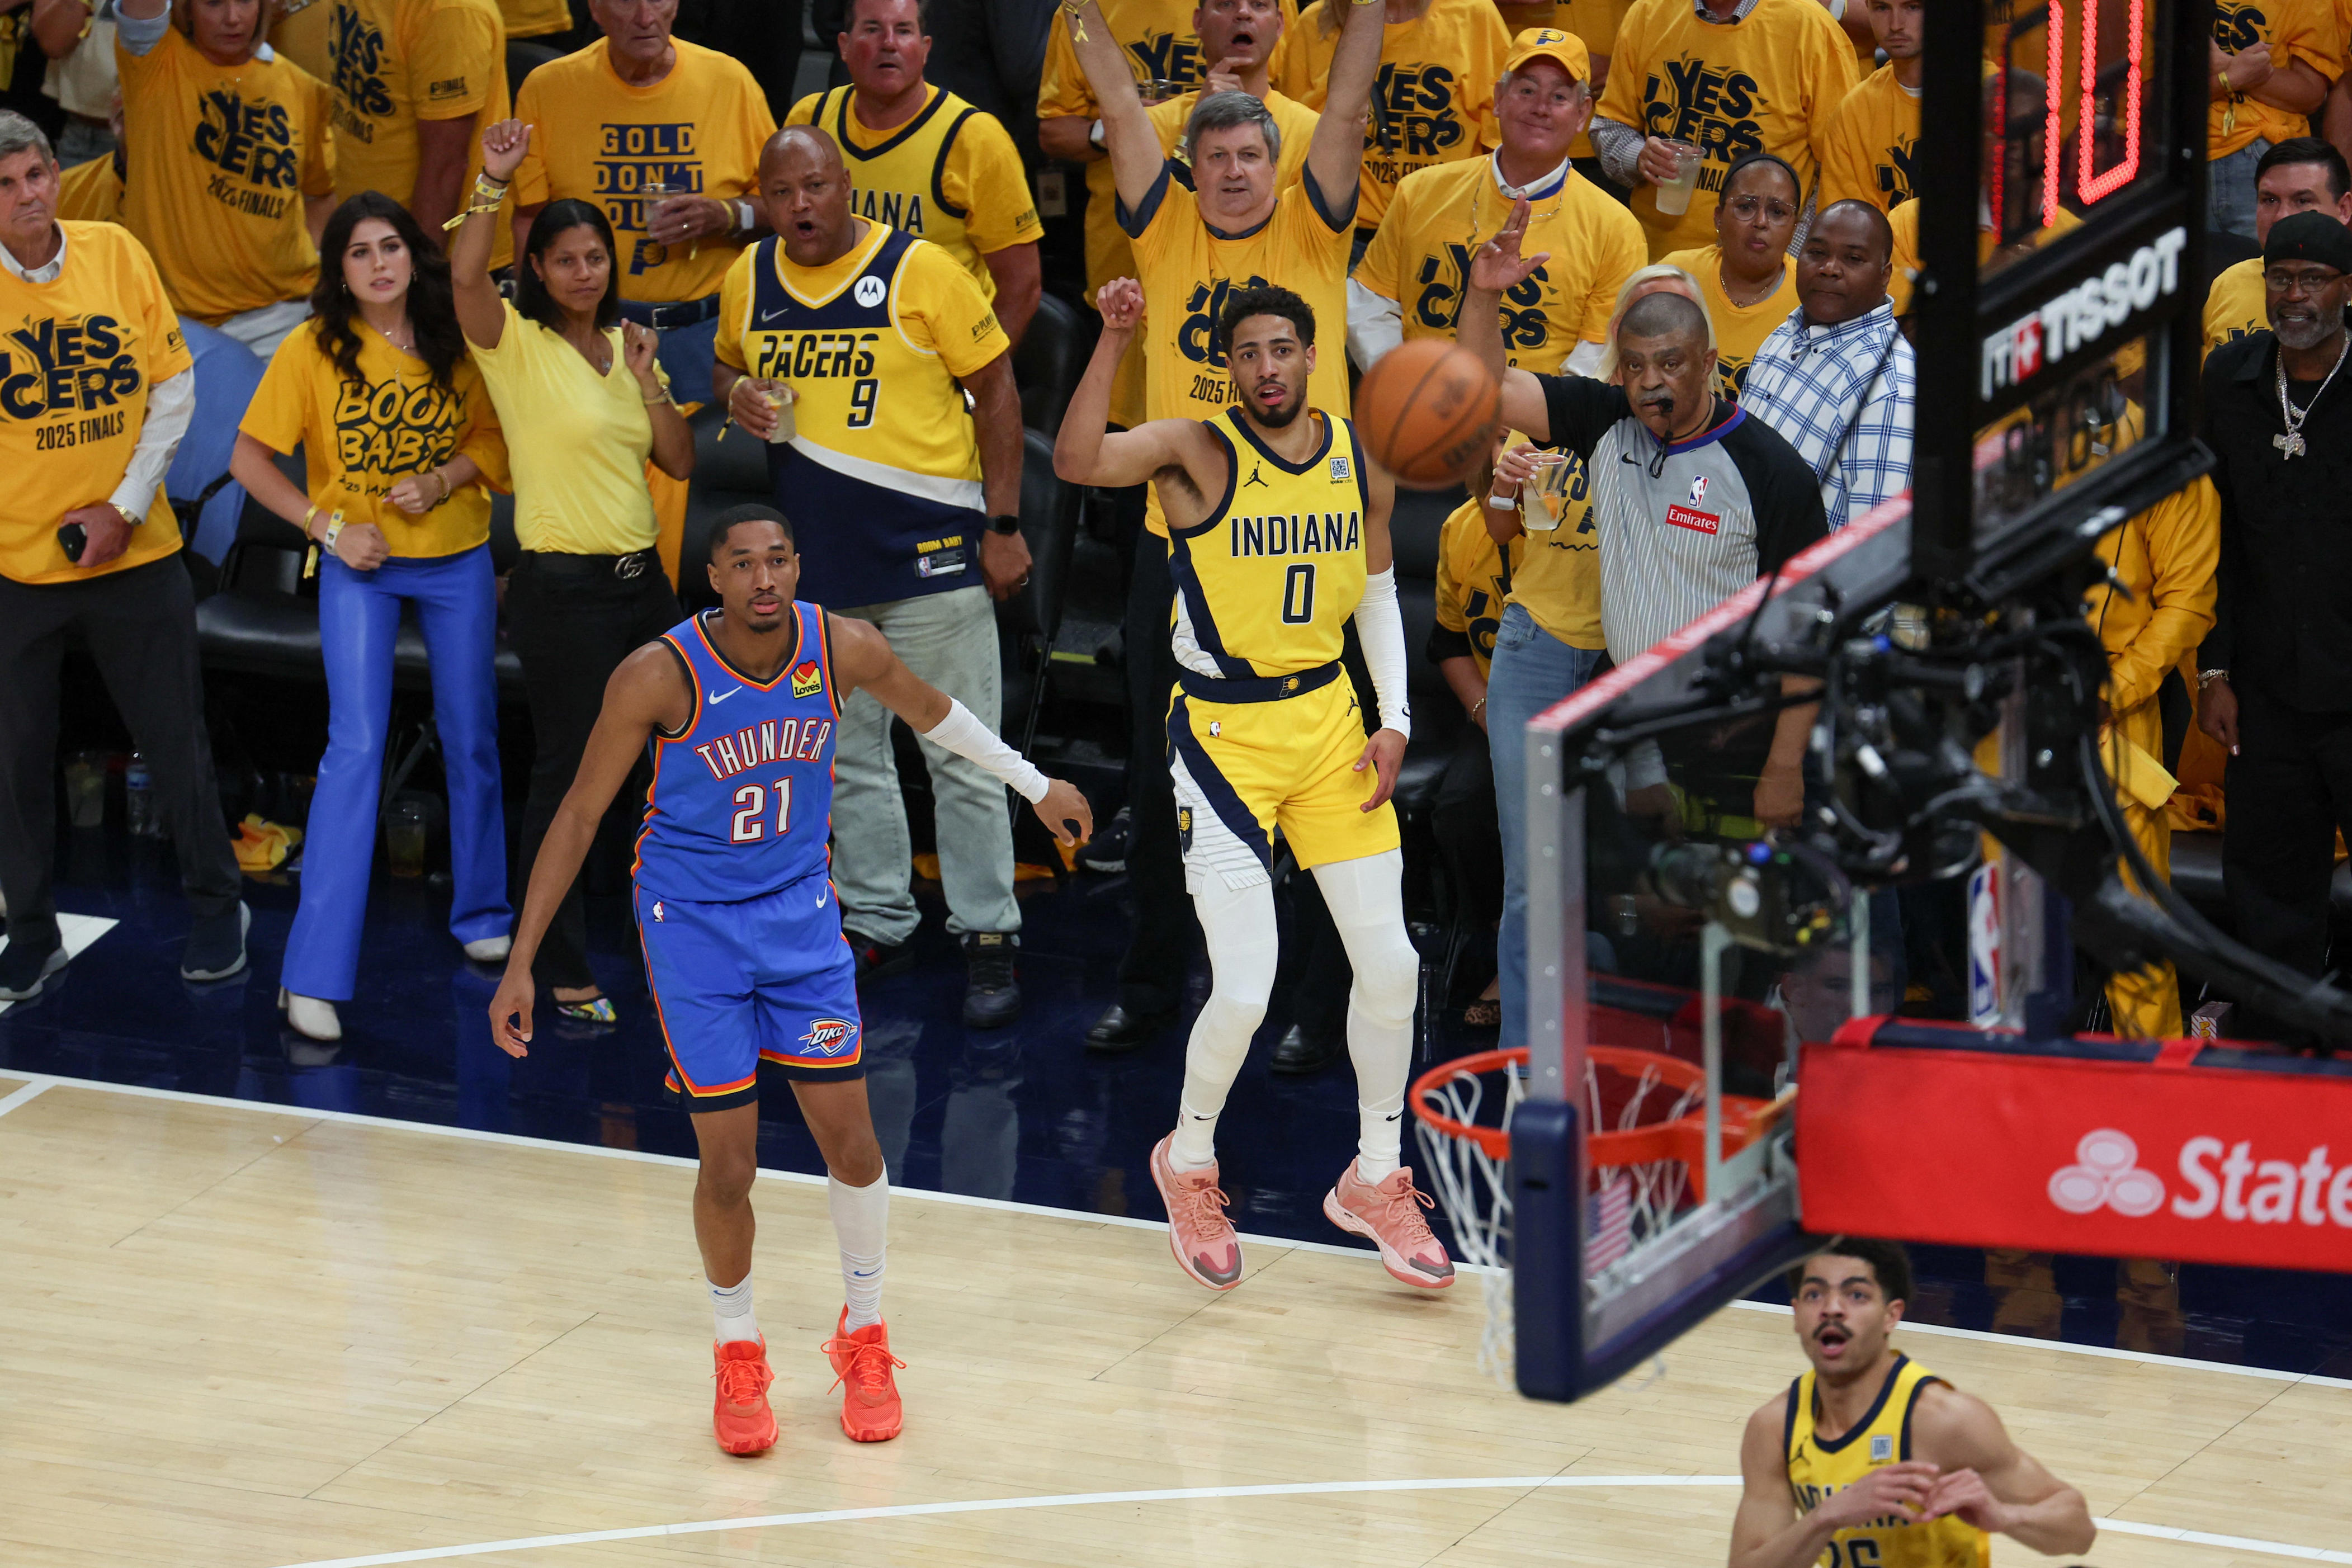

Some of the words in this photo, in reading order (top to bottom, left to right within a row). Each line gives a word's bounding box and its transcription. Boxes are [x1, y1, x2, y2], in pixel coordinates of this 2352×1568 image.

[1667, 60, 1758, 119] YES
[207, 91, 290, 145] YES
[601, 123, 695, 156] GOLD
[593, 162, 702, 193] DON'T
[237, 190, 284, 220] FINALS
[2041, 226, 2186, 363] TISSOT
[10, 315, 120, 372] YES
[758, 333, 879, 378] PACERS
[847, 379, 880, 429] 9
[1189, 375, 1226, 404] 2025
[36, 423, 75, 450] 2025
[80, 411, 124, 444] FINALS
[337, 427, 456, 475] BABY
[1231, 510, 1359, 558] INDIANA
[1669, 508, 1717, 530] Emirates
[917, 540, 942, 554] BOOM
[942, 536, 962, 547] BABY
[1282, 563, 1316, 625] 0
[694, 717, 833, 781] THUNDER
[730, 775, 793, 844] 21
[809, 1027, 844, 1046] OKC
